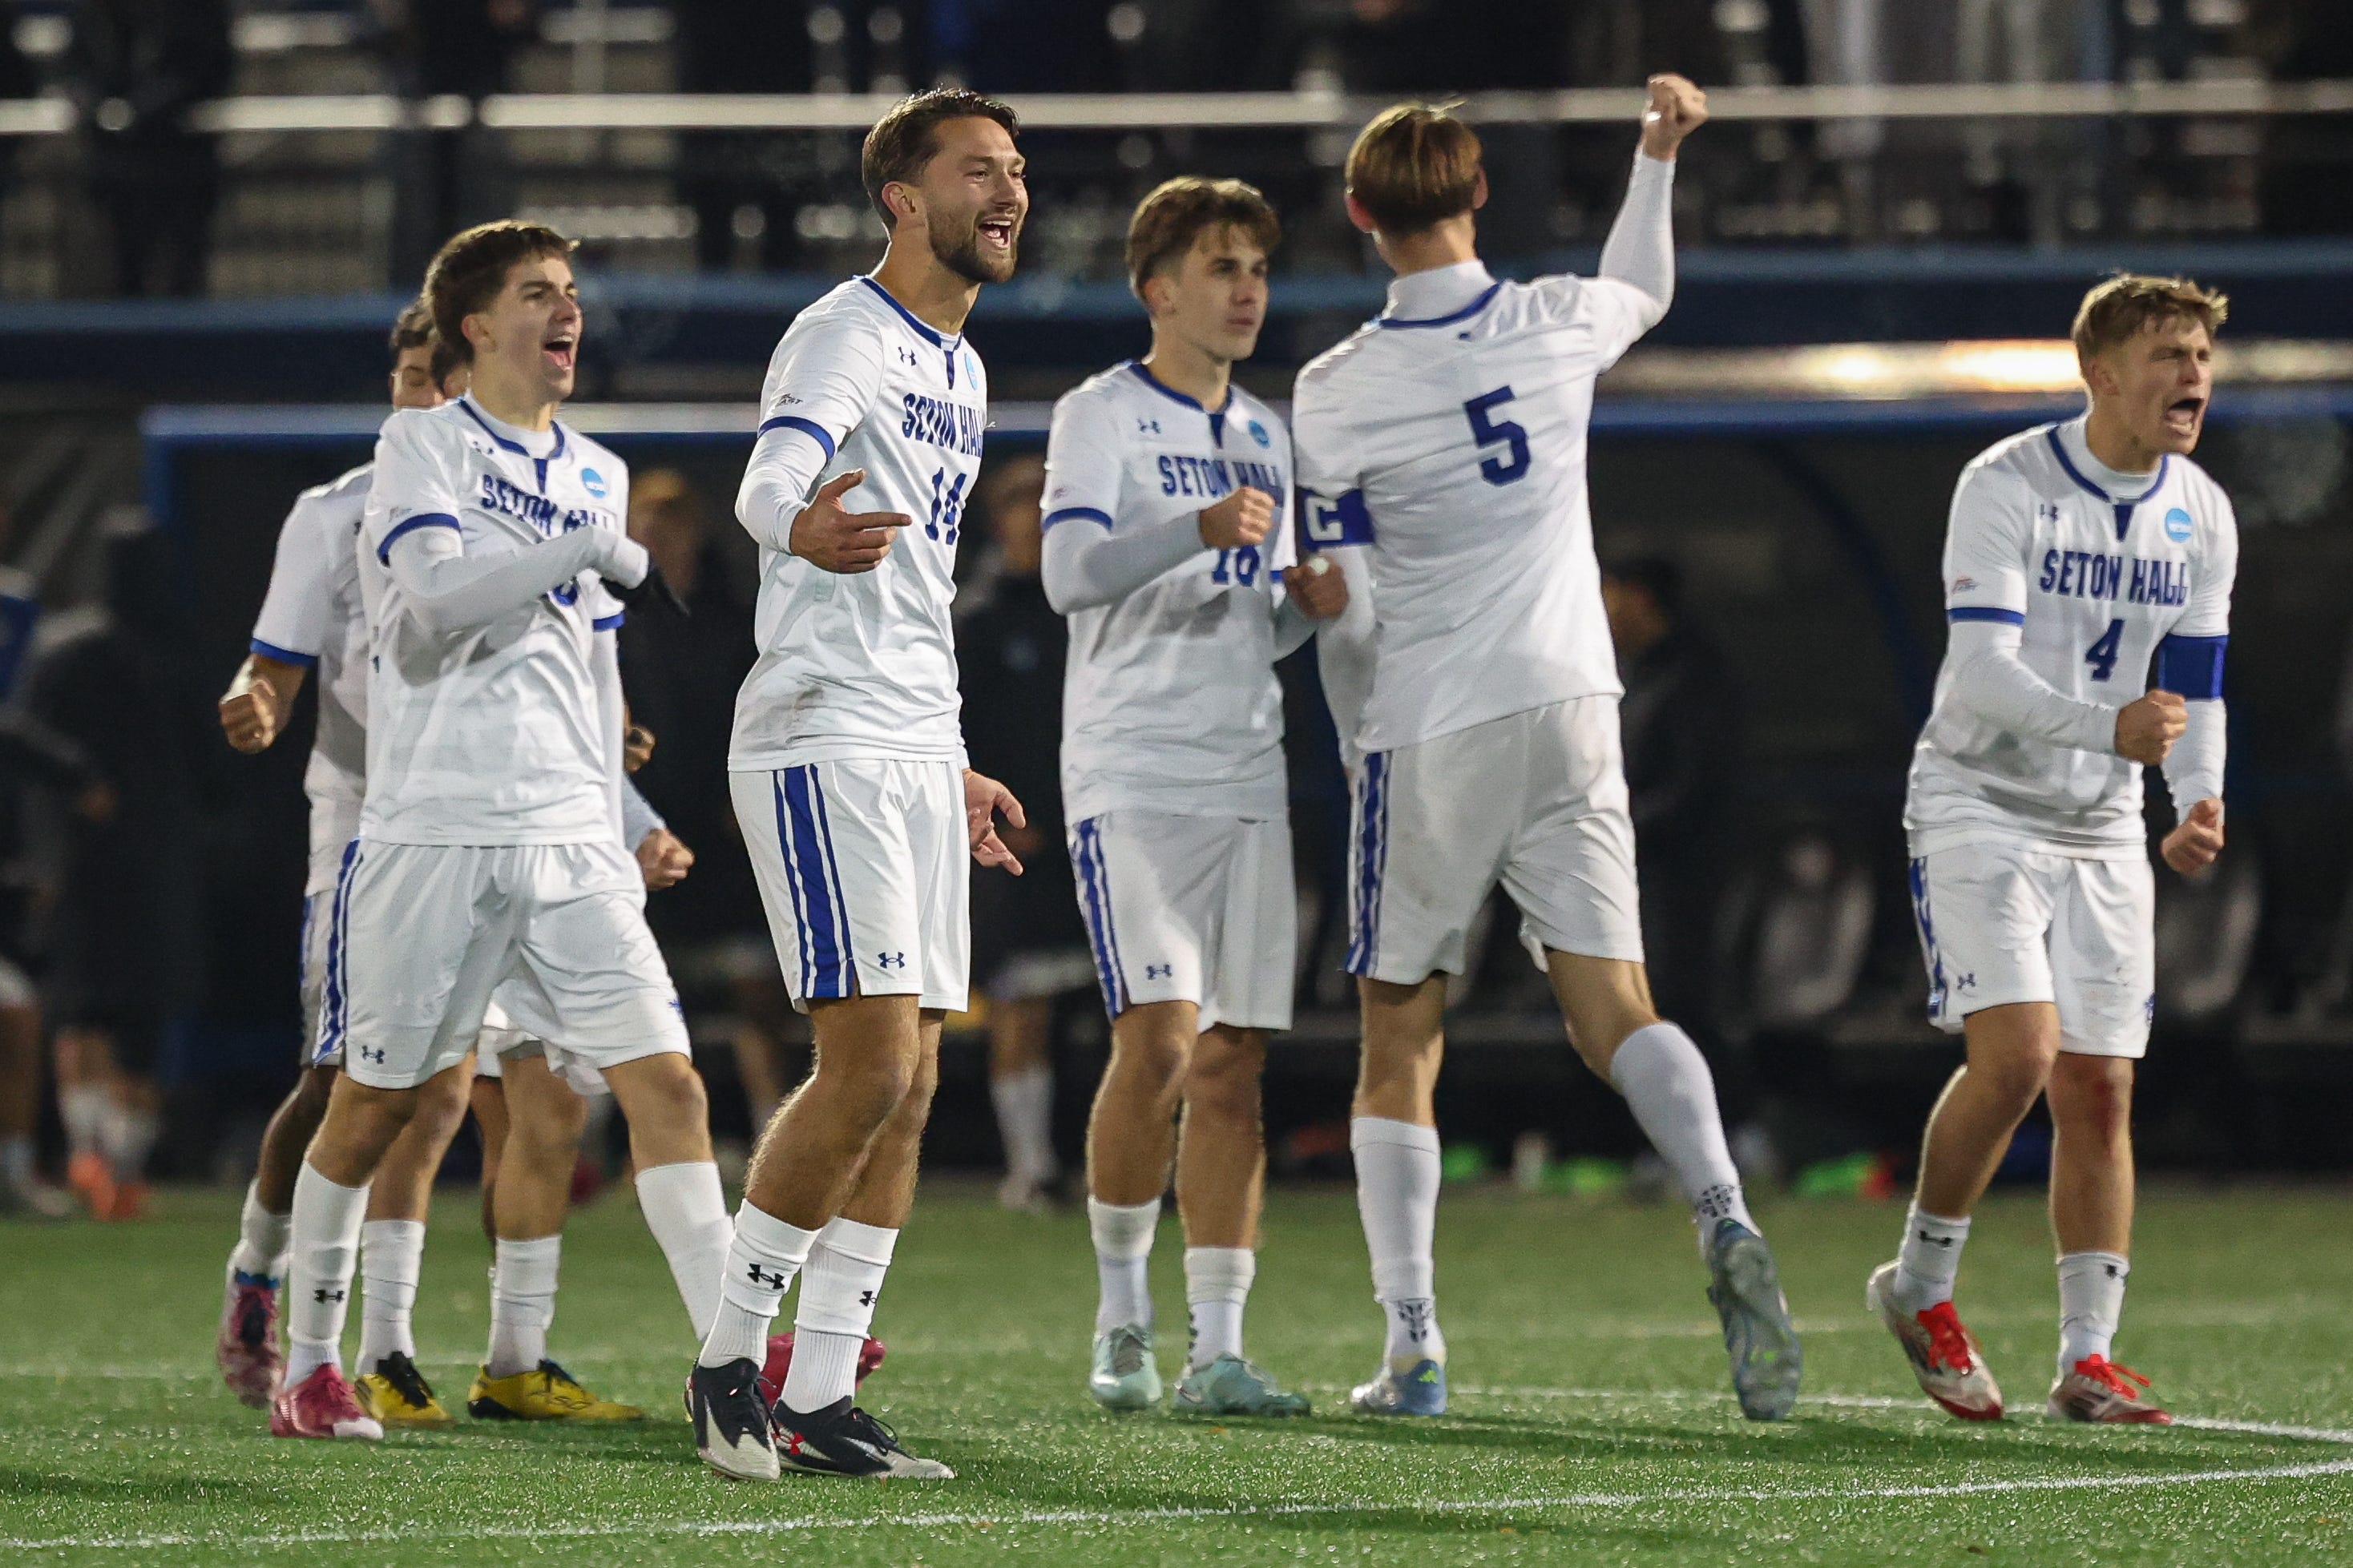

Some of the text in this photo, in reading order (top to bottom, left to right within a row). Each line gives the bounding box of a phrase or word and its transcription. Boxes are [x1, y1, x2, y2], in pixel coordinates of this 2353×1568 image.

[902, 393, 956, 450] SETON
[1463, 385, 1531, 487] 5
[925, 466, 967, 546] 14
[1304, 497, 1344, 542] C
[2040, 548, 2189, 607] SETON HALL
[2085, 619, 2125, 681] 4
